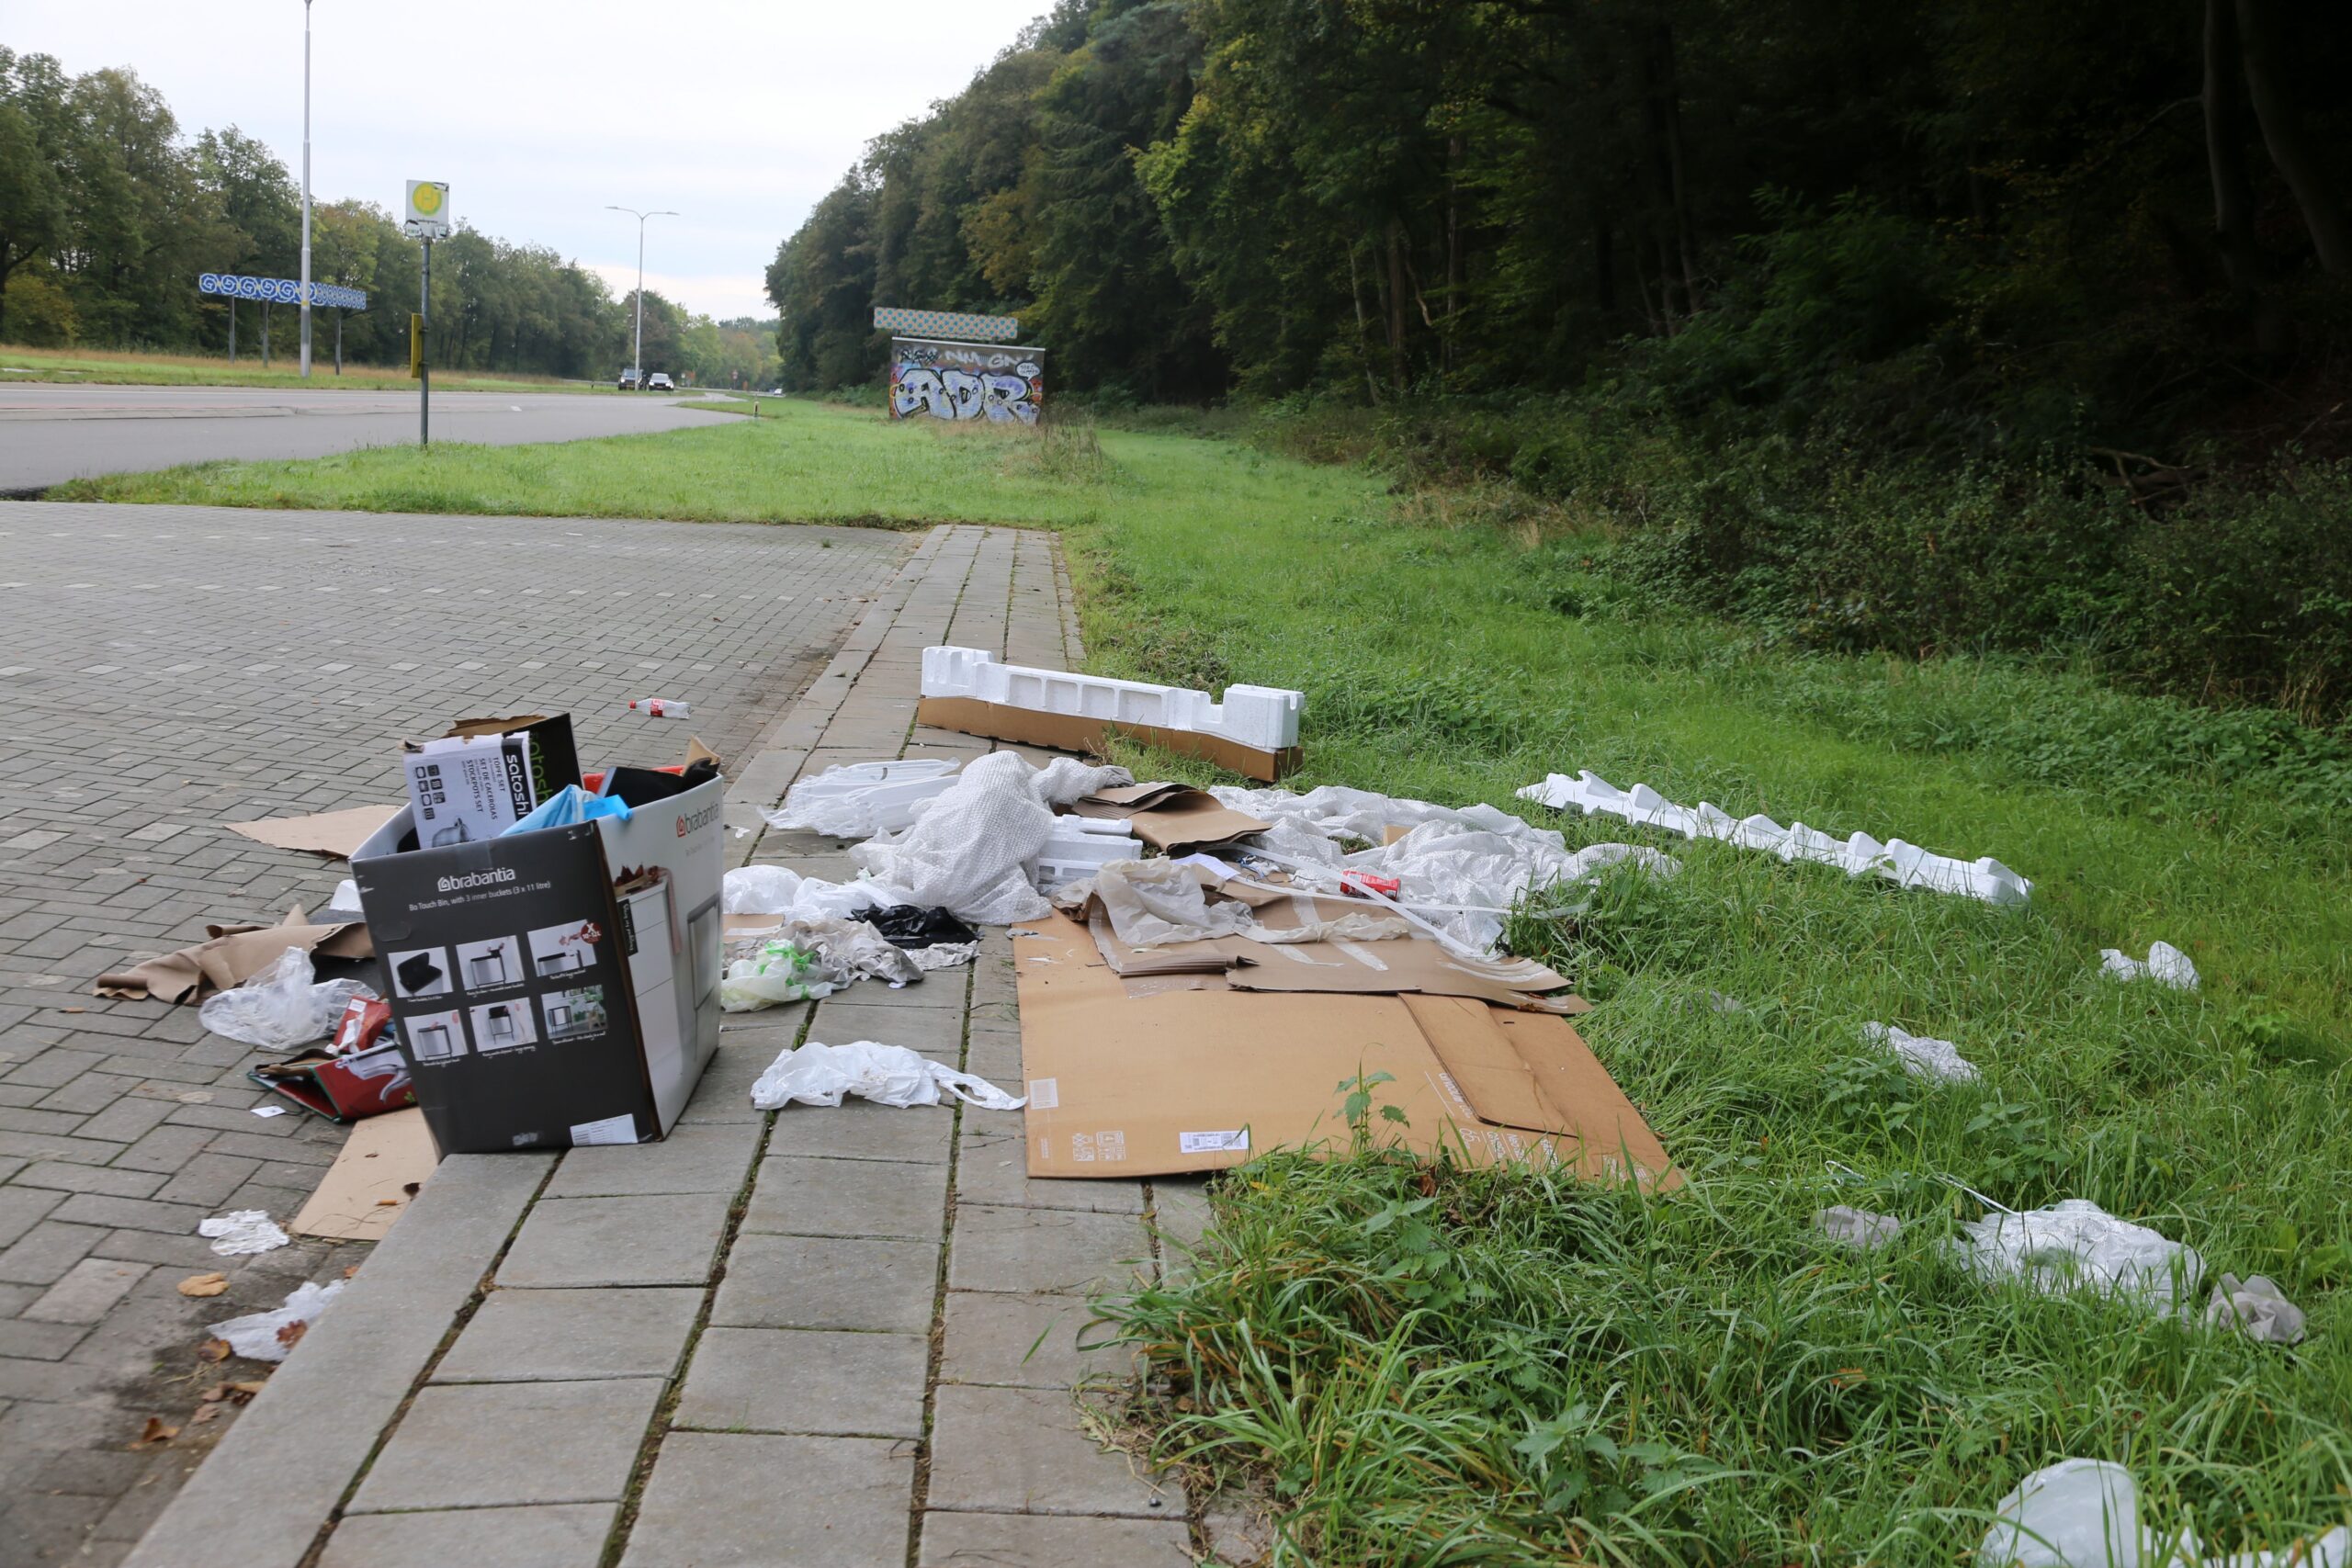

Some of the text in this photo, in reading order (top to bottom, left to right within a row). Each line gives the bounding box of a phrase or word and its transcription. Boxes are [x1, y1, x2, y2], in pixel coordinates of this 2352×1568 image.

[467, 760, 481, 799] STOCKPOTS
[475, 800, 483, 813] SET
[482, 772, 490, 781] DE
[485, 782, 498, 820] CACEROLAS
[450, 867, 516, 890] brabantia
[418, 900, 436, 910] Touch
[437, 898, 450, 908] Bin,
[451, 896, 465, 905] with
[471, 892, 487, 901] inner
[489, 888, 512, 899] buckets
[513, 886, 520, 896] (3
[527, 884, 535, 892] 11
[536, 880, 551, 890] litre)
